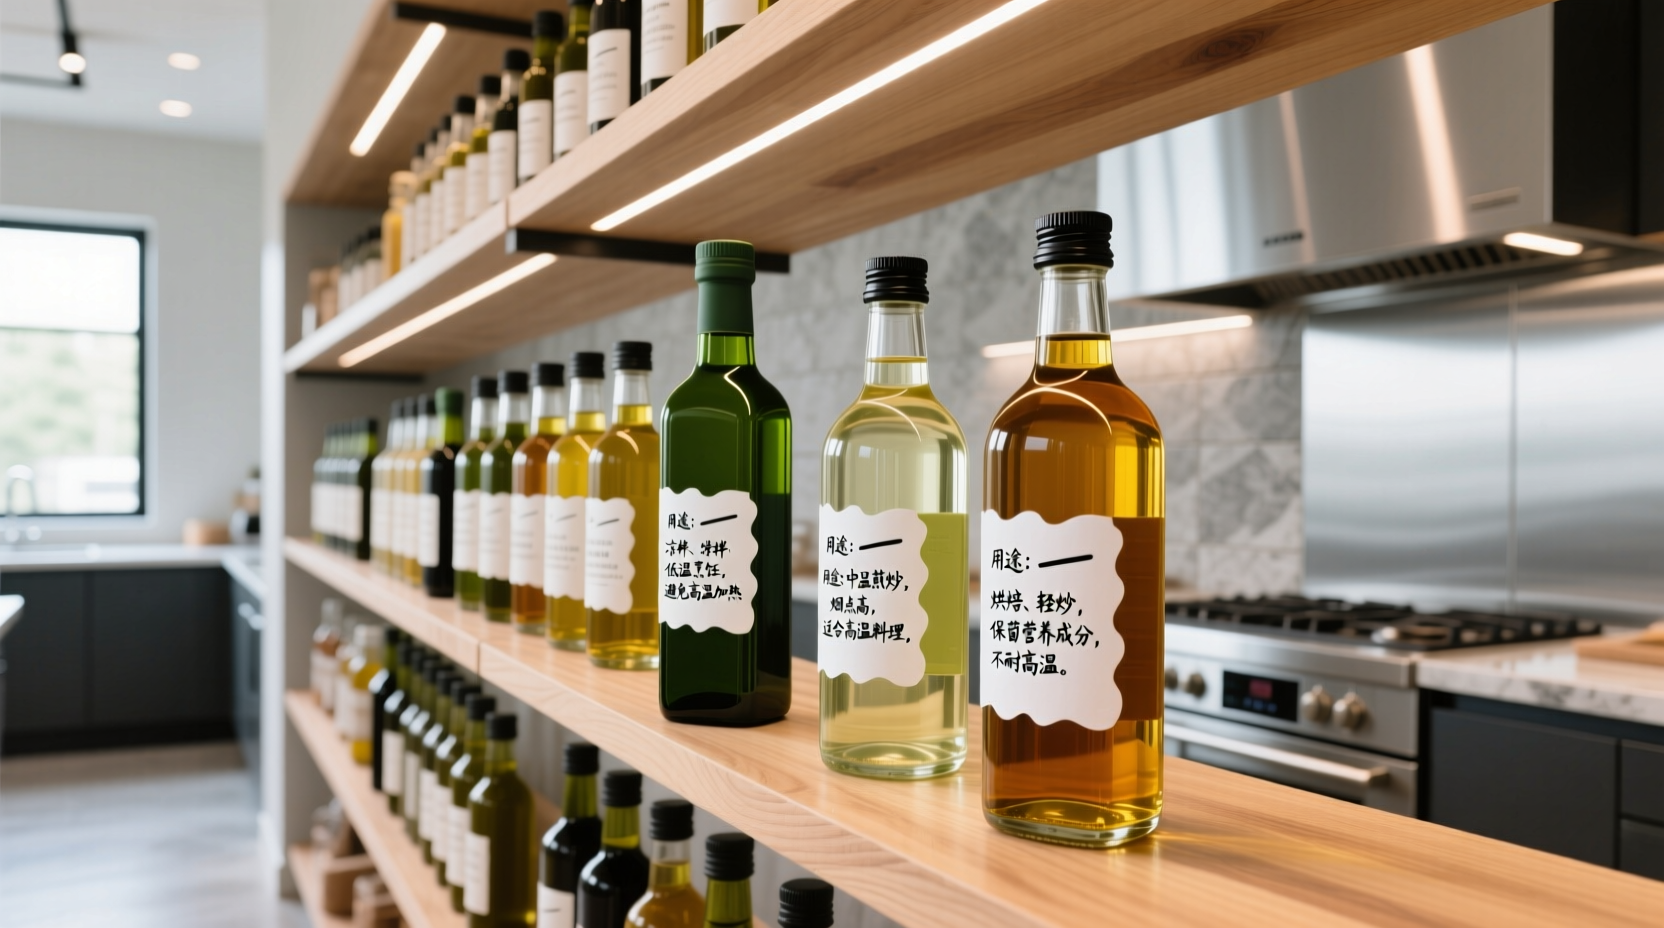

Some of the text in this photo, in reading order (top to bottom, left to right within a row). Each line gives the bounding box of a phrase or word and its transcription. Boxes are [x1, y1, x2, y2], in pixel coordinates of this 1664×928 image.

[990, 547, 1031, 574] 用途：
[990, 649, 1068, 677] 不耐高温。
